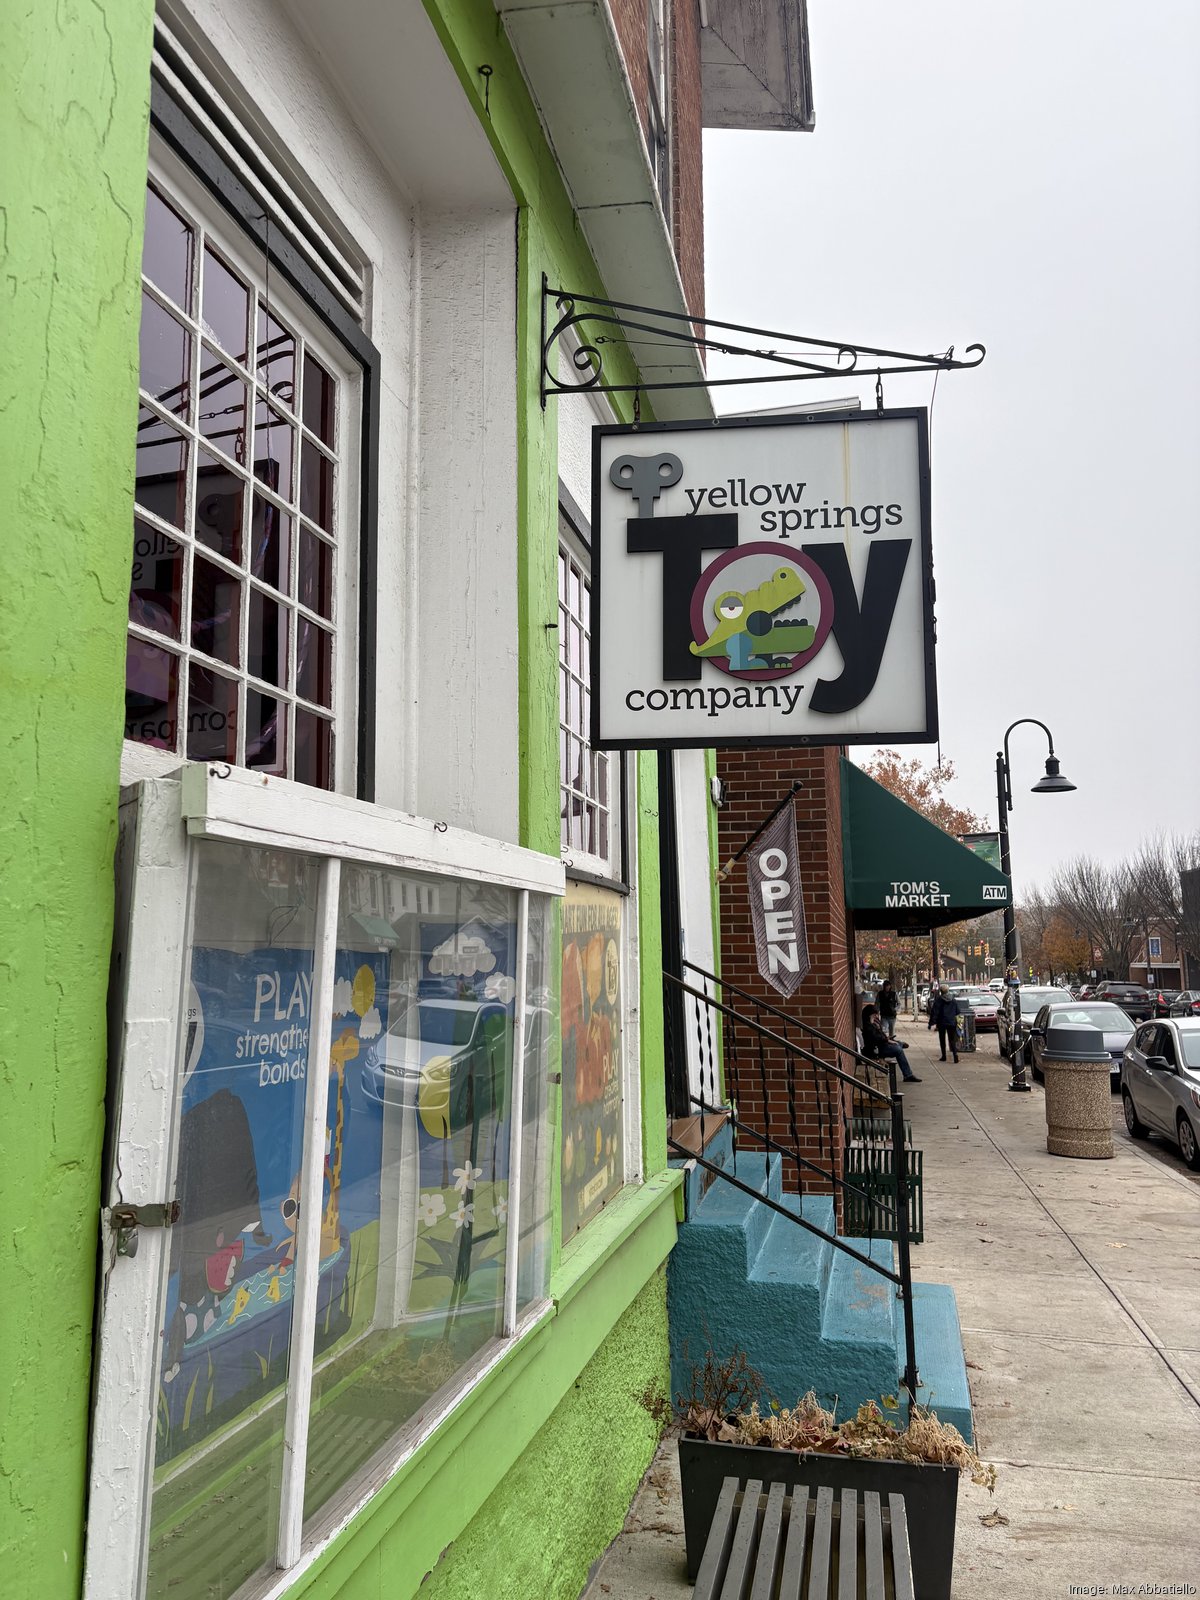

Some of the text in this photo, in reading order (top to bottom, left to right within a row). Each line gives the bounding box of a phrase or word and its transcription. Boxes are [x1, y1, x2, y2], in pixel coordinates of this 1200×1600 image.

[684, 478, 806, 517] yellow
[760, 500, 903, 539] springs
[625, 685, 804, 716] company
[885, 894, 950, 908] MARKET
[890, 881, 940, 894] TOM'S
[983, 887, 1006, 898] ATM
[758, 847, 800, 975] OPEN
[253, 970, 313, 1022] PLAY
[236, 1023, 309, 1058] strengthe
[259, 1053, 306, 1087] bonds
[603, 1048, 619, 1083] PLAY
